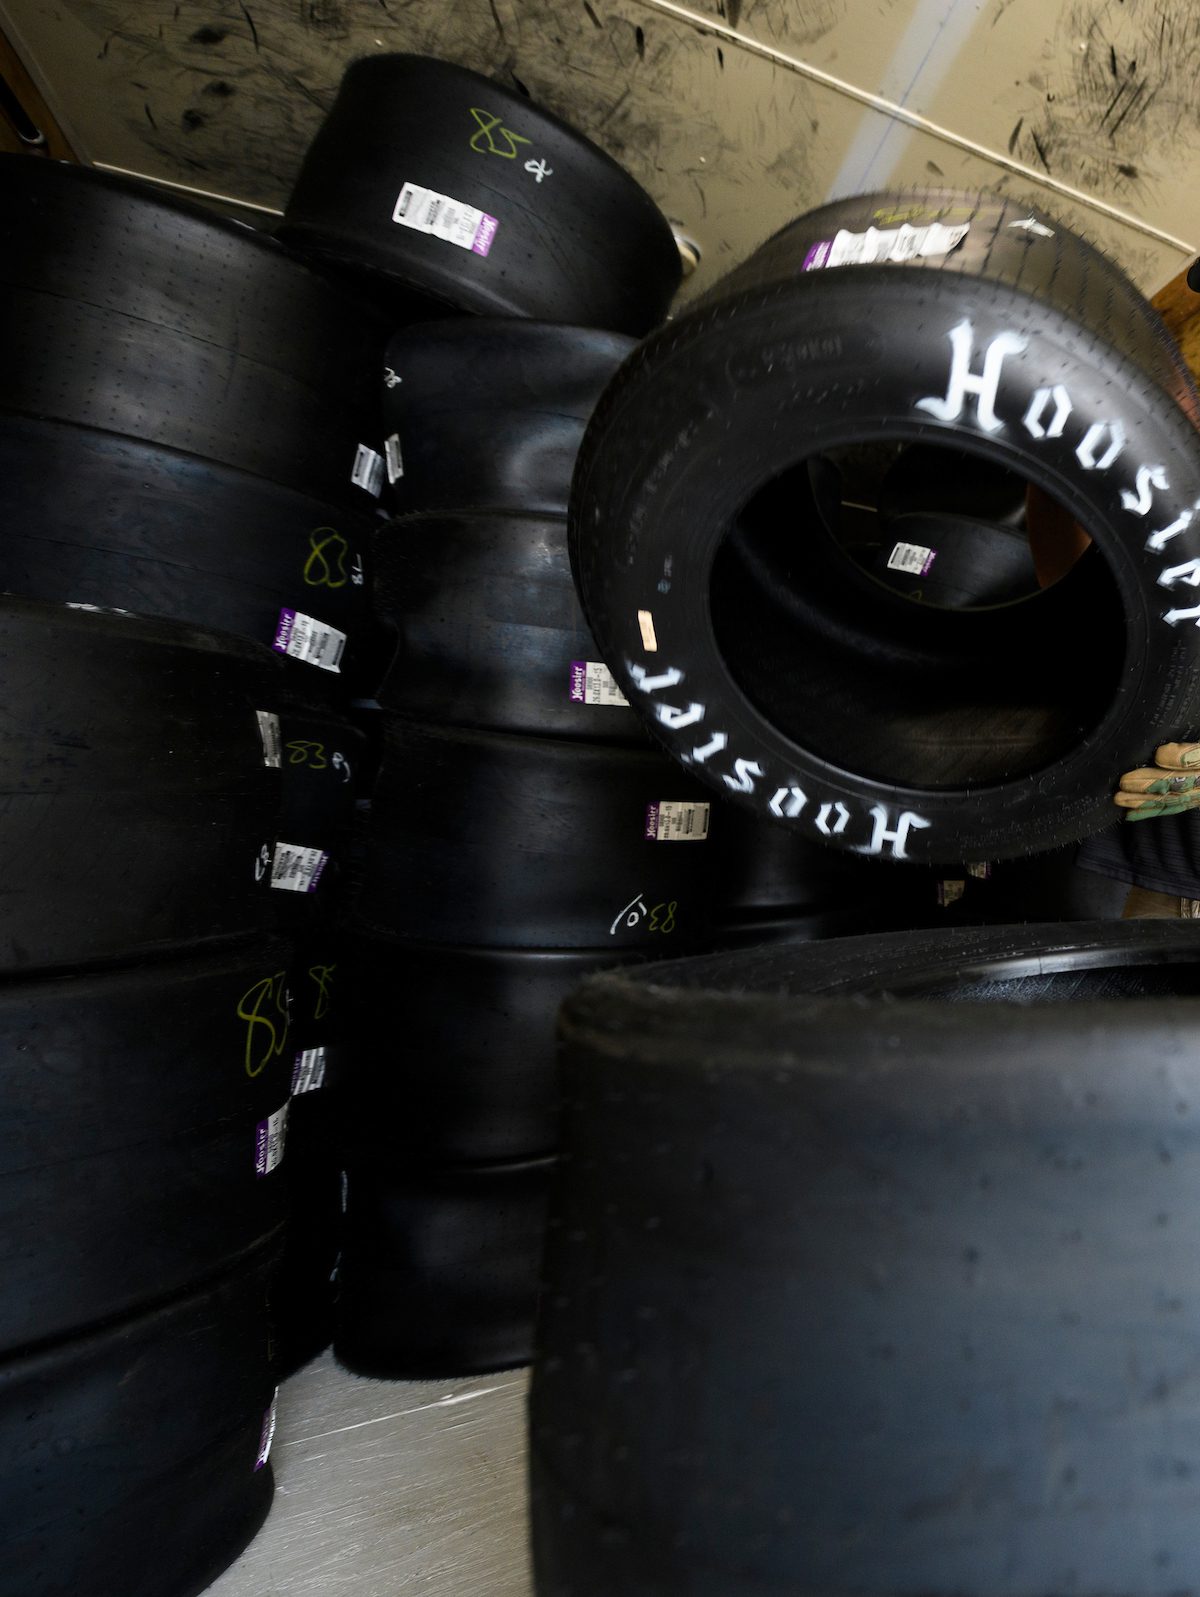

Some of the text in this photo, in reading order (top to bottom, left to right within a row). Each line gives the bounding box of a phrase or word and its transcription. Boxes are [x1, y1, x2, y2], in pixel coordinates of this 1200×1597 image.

[274, 613, 293, 651] Hoosier
[571, 666, 583, 701] Hoosier
[286, 740, 328, 769] 83
[626, 657, 932, 860] Hoosier
[646, 805, 657, 838] Hoosier
[256, 1128, 267, 1174] Hoosier
